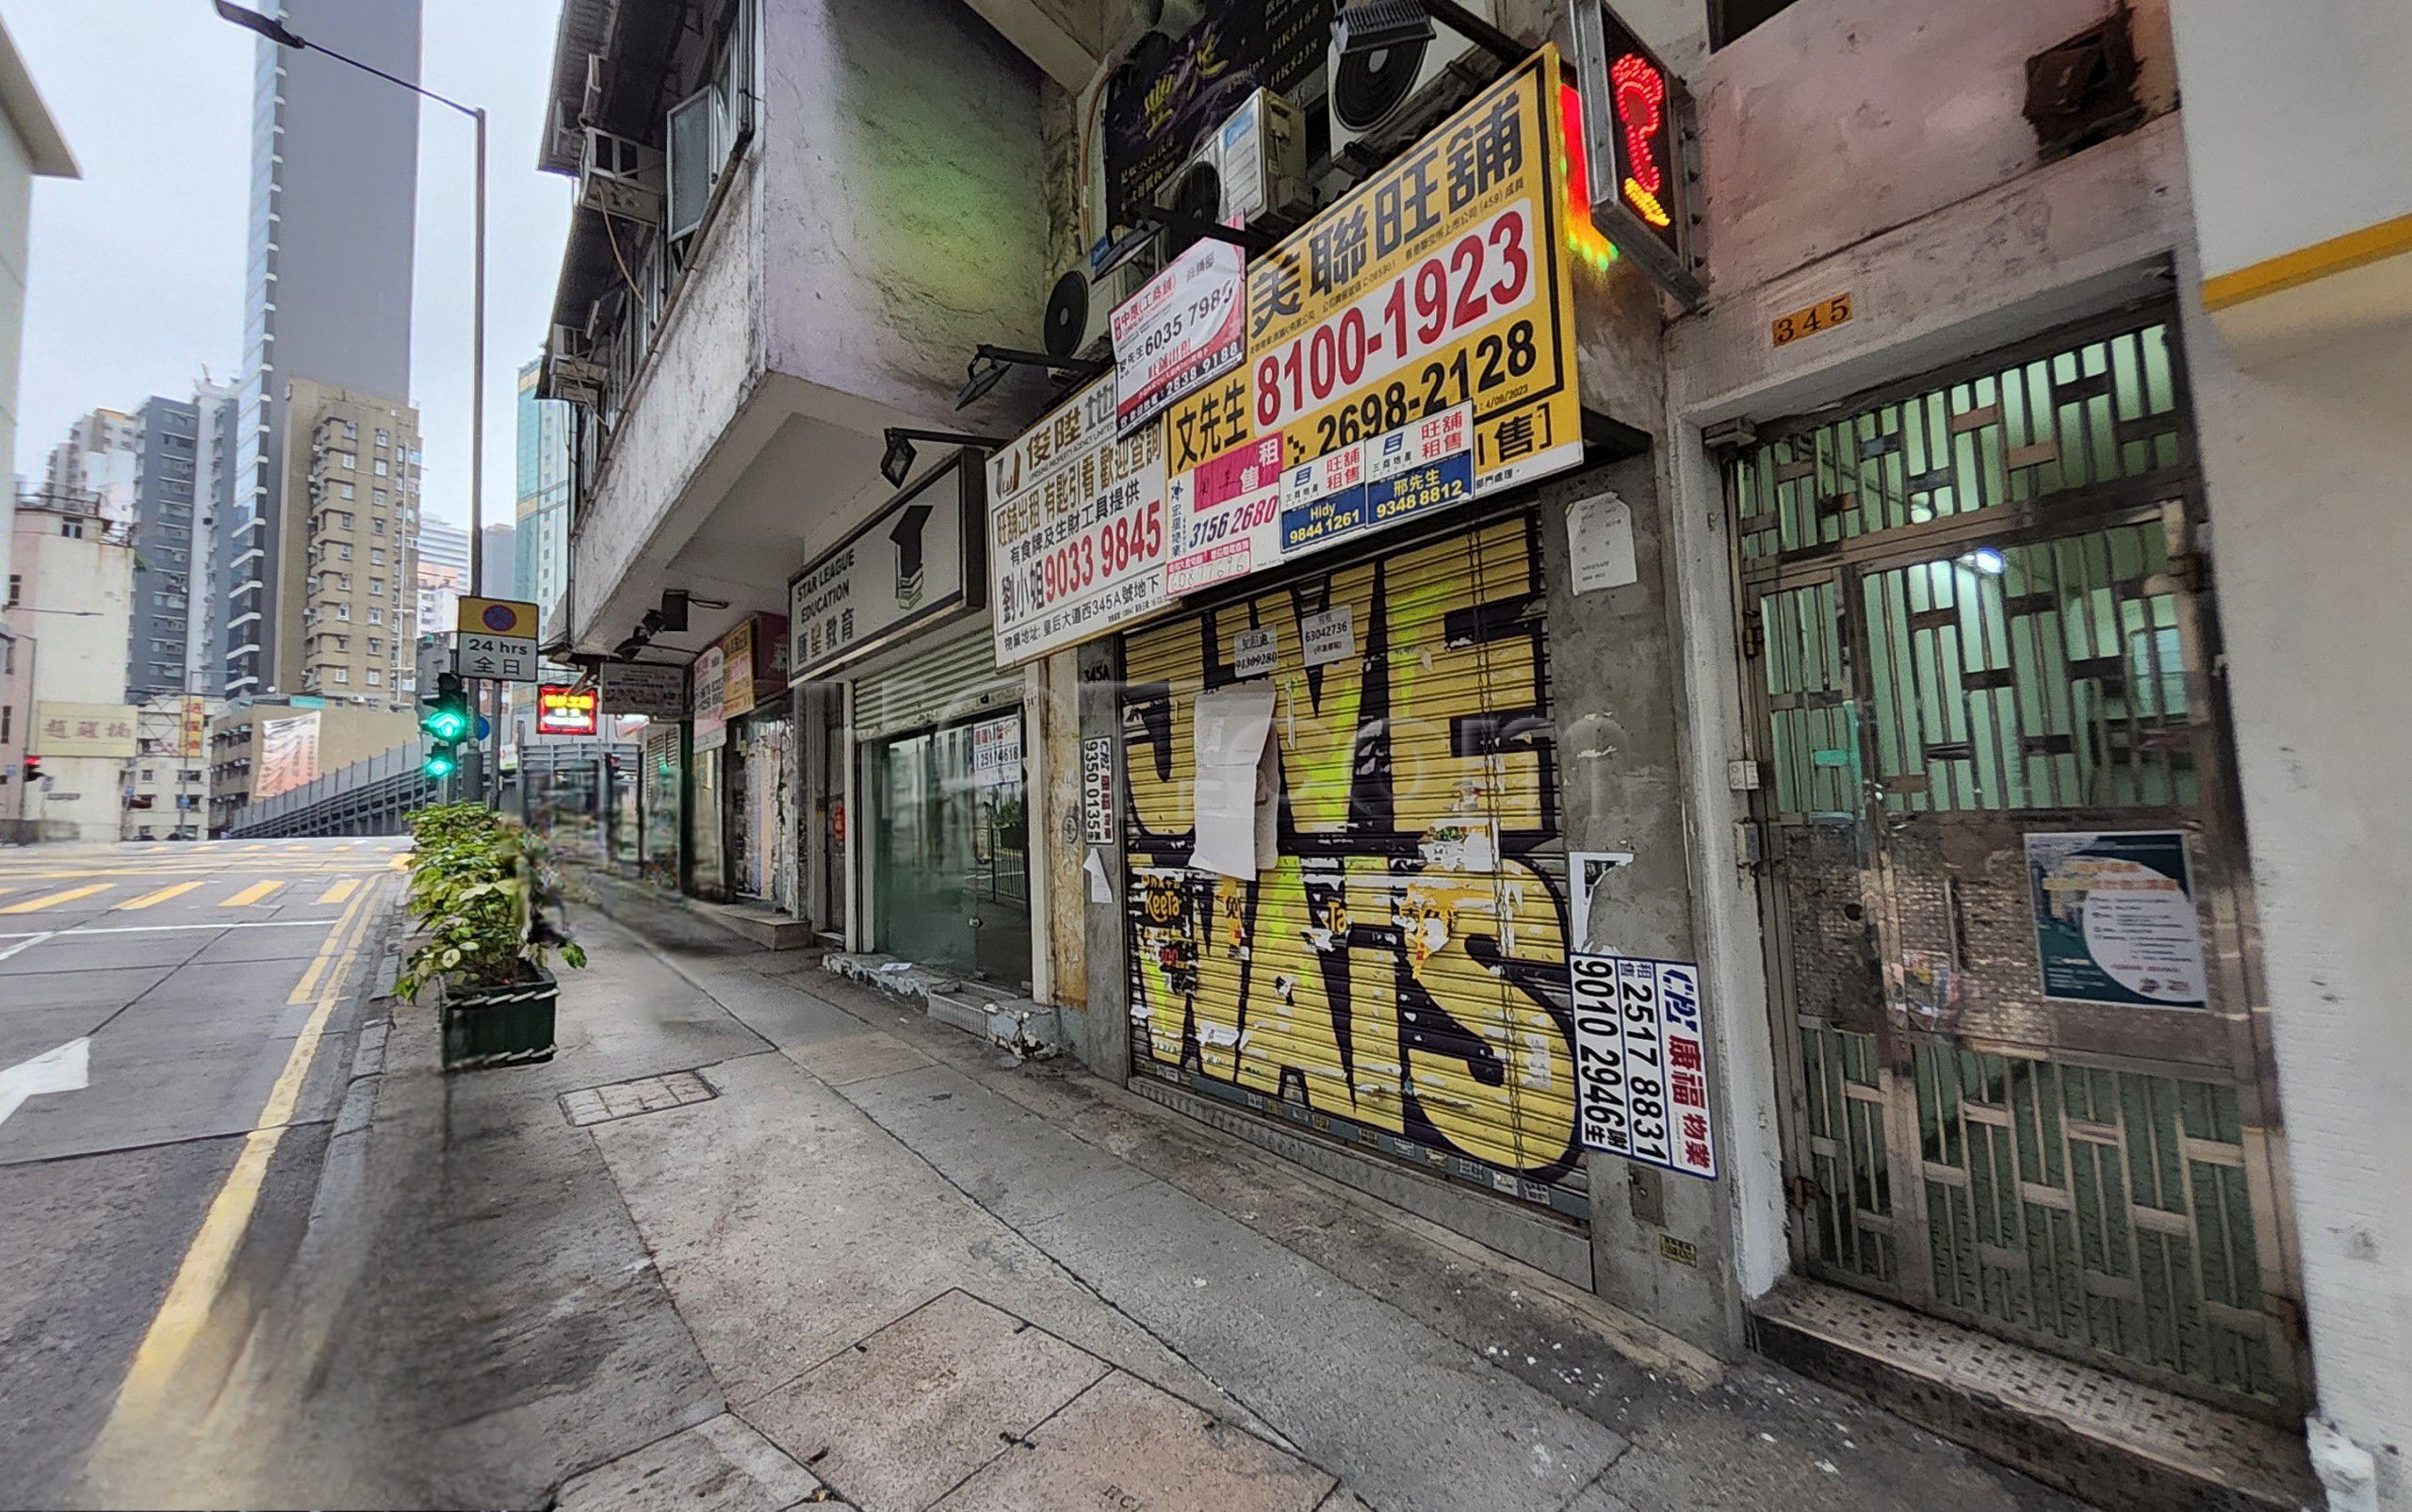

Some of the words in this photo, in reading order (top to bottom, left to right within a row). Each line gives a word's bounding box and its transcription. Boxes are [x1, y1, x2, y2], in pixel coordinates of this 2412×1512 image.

[1251, 90, 1523, 339] 美聯旺舖
[1145, 313, 1182, 356] 6035
[1257, 211, 1529, 427] 8100-1923
[1777, 297, 1850, 343] 345
[1166, 366, 1197, 396] 2838
[1202, 342, 1238, 373] 9188
[1318, 320, 1537, 454] 2698-2128
[1177, 379, 1248, 471] 文先生
[1421, 410, 1462, 439] 旺舖
[1421, 432, 1462, 460] 租售
[1259, 438, 1279, 467] 租
[1327, 447, 1361, 472] 旺舖
[1044, 454, 1095, 522] 有匙引看
[1240, 465, 1261, 494] 售
[1327, 468, 1361, 491] 租售
[1377, 496, 1417, 519] 9348
[1419, 480, 1462, 507] 8812
[1010, 479, 1140, 566] 有食牌及生財工具提供
[1189, 512, 1230, 548] 3156
[1230, 495, 1279, 535] 2680
[1290, 522, 1324, 544] 9844
[1326, 510, 1360, 533] 1261
[798, 576, 818, 603] STAR
[819, 548, 855, 587] LEAGUE
[1002, 561, 1044, 625] 劉小姐
[1044, 534, 1094, 603] 9033
[1100, 499, 1162, 577] 9845
[801, 578, 850, 625] EDUCATION
[1043, 573, 1160, 637] 皇后大道西345A號地下
[468, 638, 494, 652] 24
[499, 641, 528, 656] hrs
[1305, 621, 1348, 642] 63042736
[473, 656, 520, 675] 全日
[1084, 663, 1110, 683] 345A
[1085, 741, 1100, 784] 9350
[1086, 789, 1100, 830] 0135
[1145, 889, 1182, 922] KeeTa
[1573, 959, 1620, 1038] 9010
[1621, 983, 1657, 1068] 2517
[1578, 1048, 1625, 1135] 2946
[1669, 1034, 1712, 1169] 康福物業
[1630, 1075, 1667, 1163] 8831
